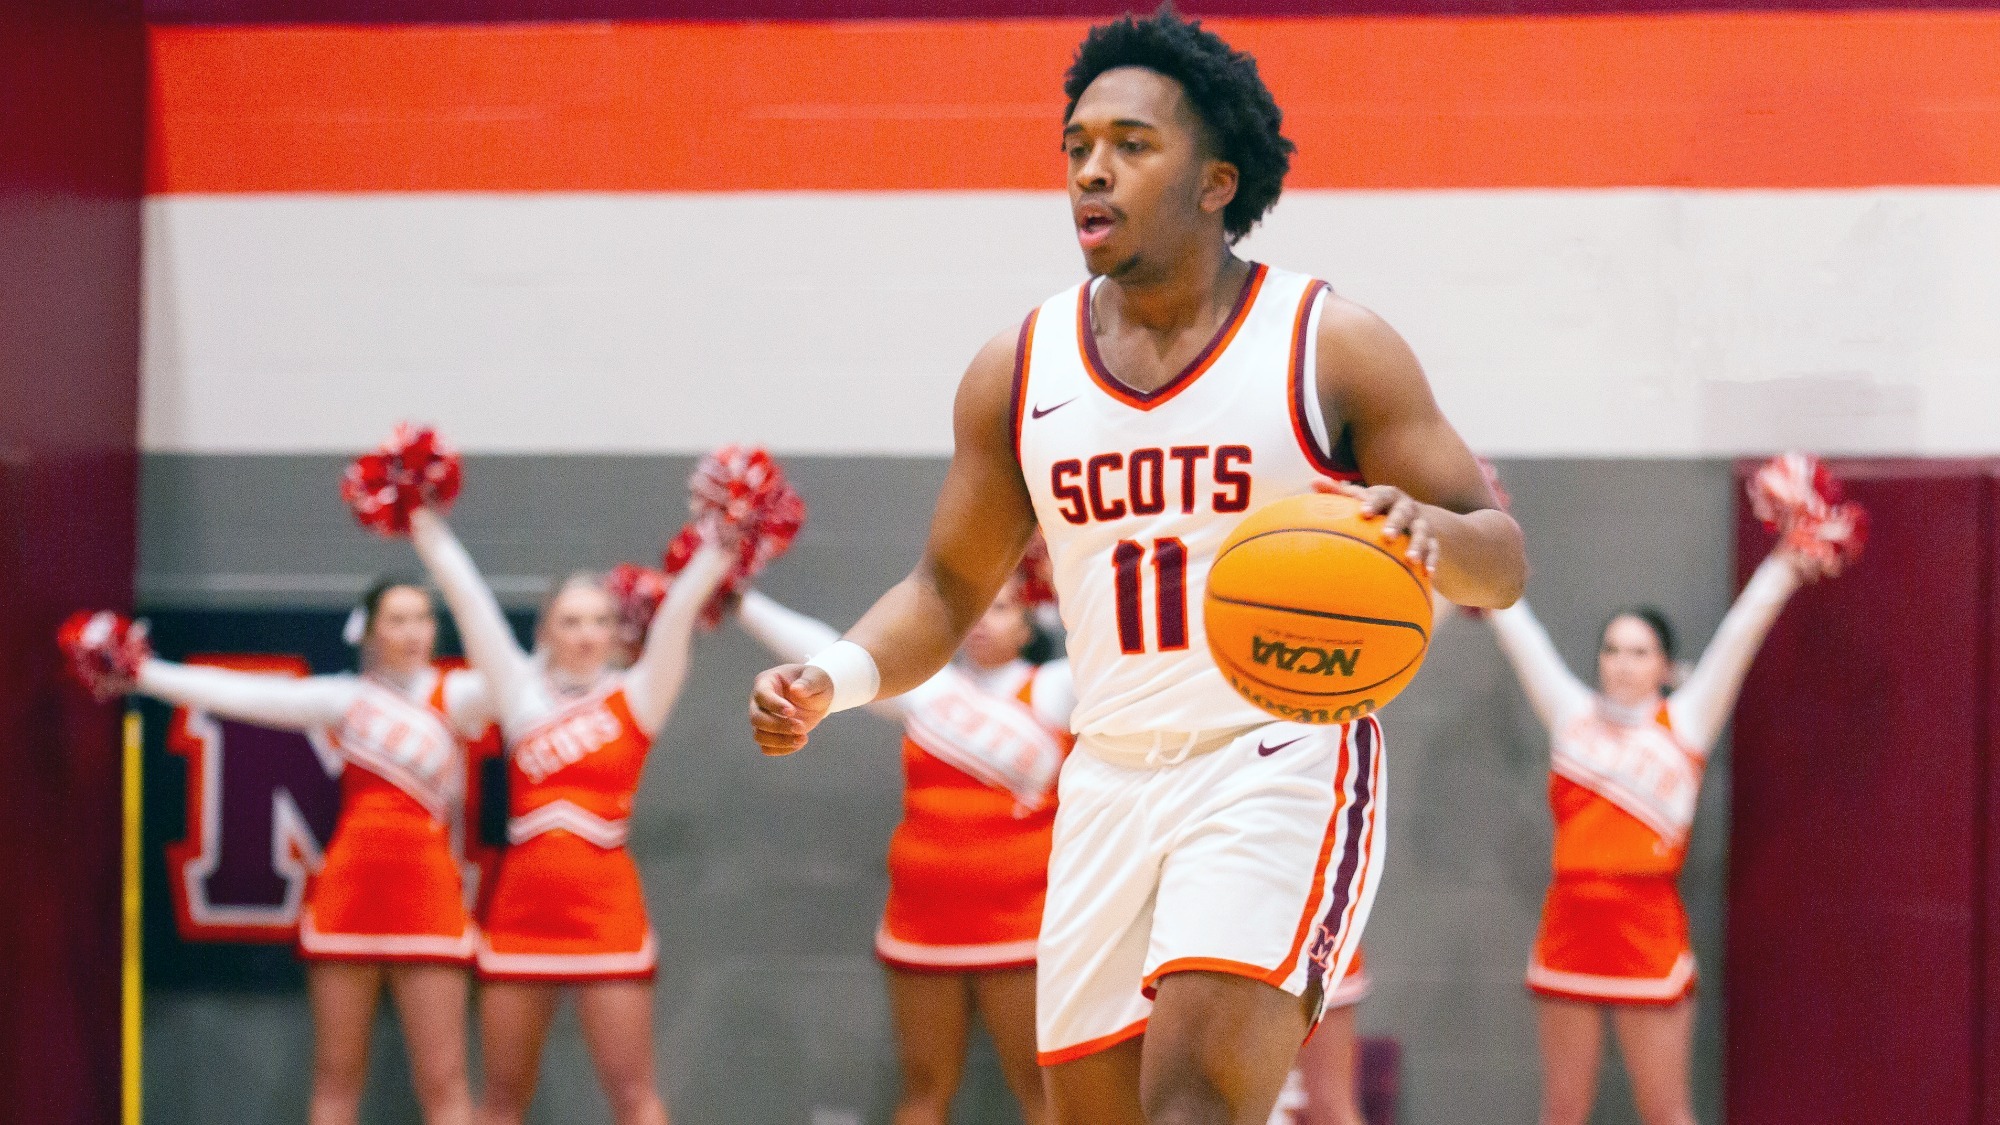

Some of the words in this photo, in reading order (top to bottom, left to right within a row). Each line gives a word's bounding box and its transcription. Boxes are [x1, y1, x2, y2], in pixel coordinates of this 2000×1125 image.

[1051, 444, 1252, 526] SCOTS
[1111, 536, 1189, 656] 11
[1253, 634, 1362, 677] NCAA
